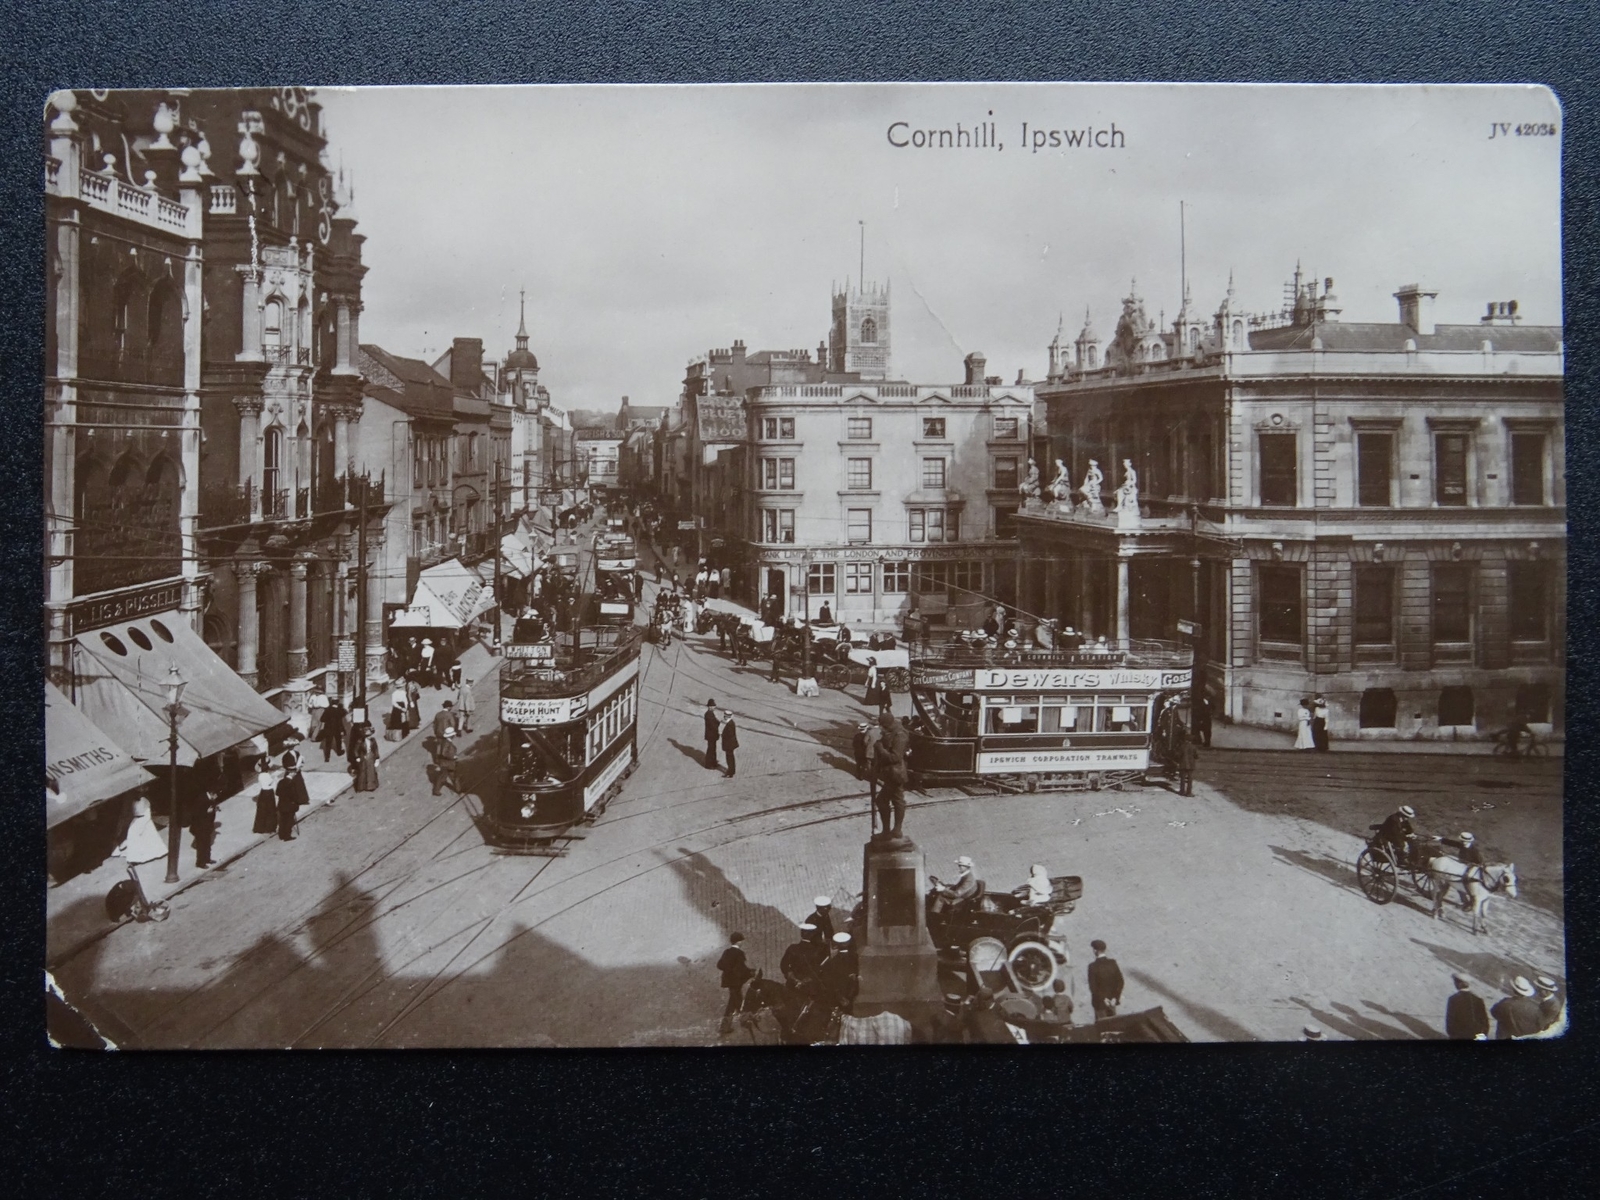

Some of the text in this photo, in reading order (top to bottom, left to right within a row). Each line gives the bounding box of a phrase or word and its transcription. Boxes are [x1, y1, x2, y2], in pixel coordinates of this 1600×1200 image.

[822, 550, 839, 559] THE
[844, 549, 880, 558] LONDON
[885, 549, 904, 558] AND
[922, 674, 948, 684] CLOTHING
[948, 670, 973, 681] COMPANY
[506, 706, 536, 716] JOSEPH
[537, 706, 561, 715] HUNT
[989, 753, 1139, 764] IPSWICH CORPORATION TRAMWAYS
